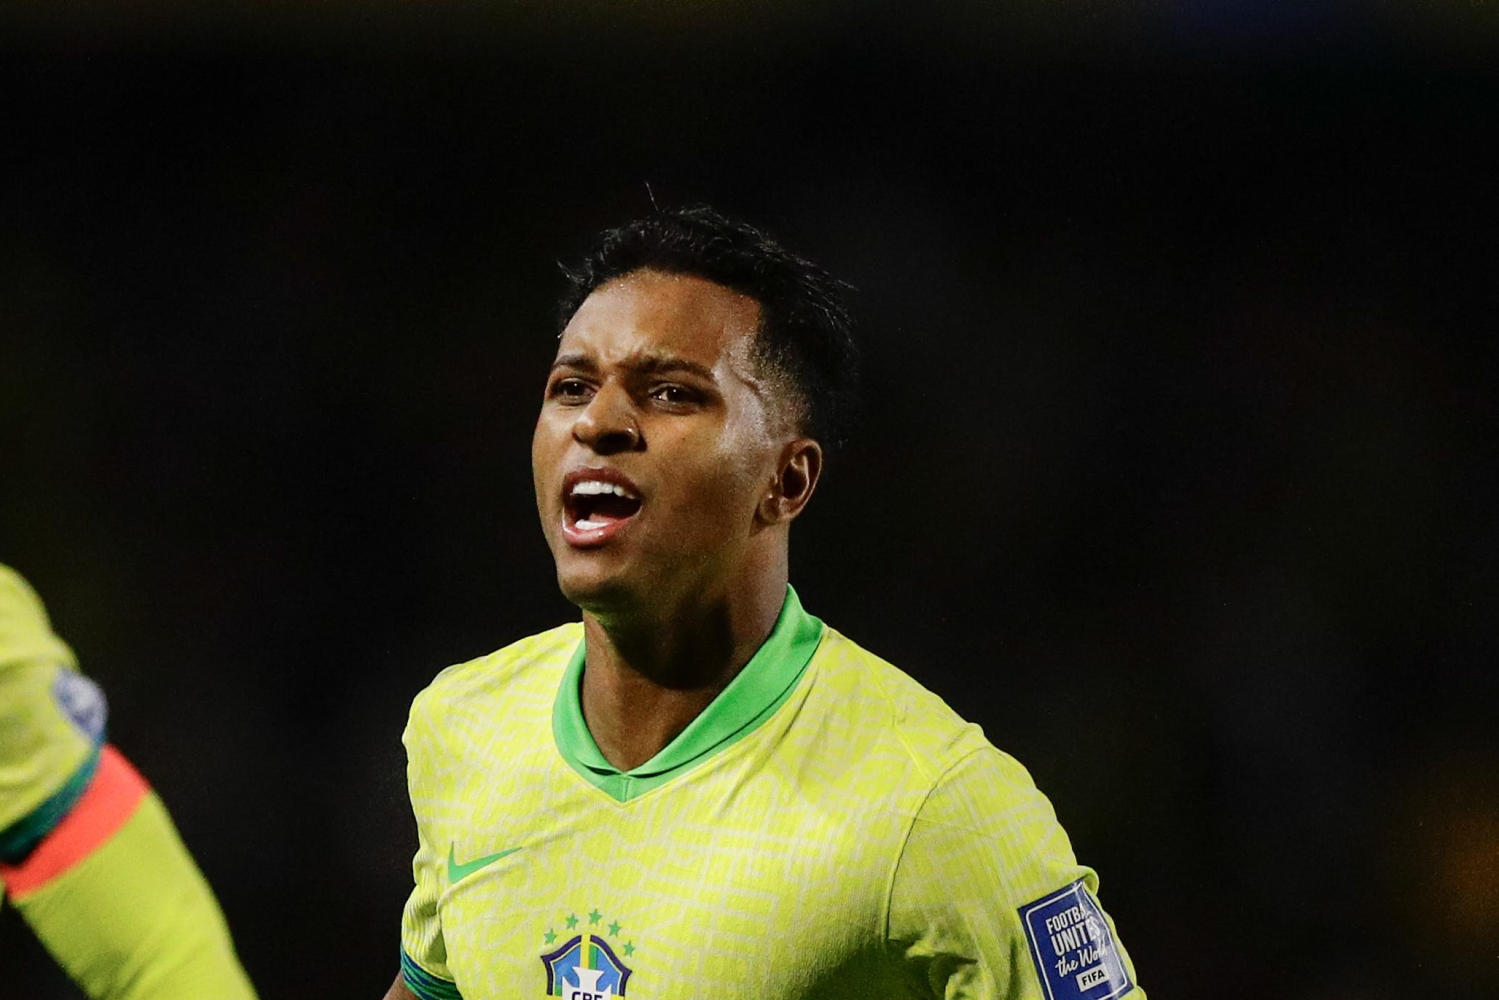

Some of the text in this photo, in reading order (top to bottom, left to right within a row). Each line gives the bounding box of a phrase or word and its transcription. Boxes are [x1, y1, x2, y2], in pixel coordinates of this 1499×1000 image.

[1045, 904, 1094, 935] FOOTBA
[1051, 916, 1101, 956] UNITES
[1055, 956, 1079, 977] the
[1082, 970, 1105, 986] FIFA
